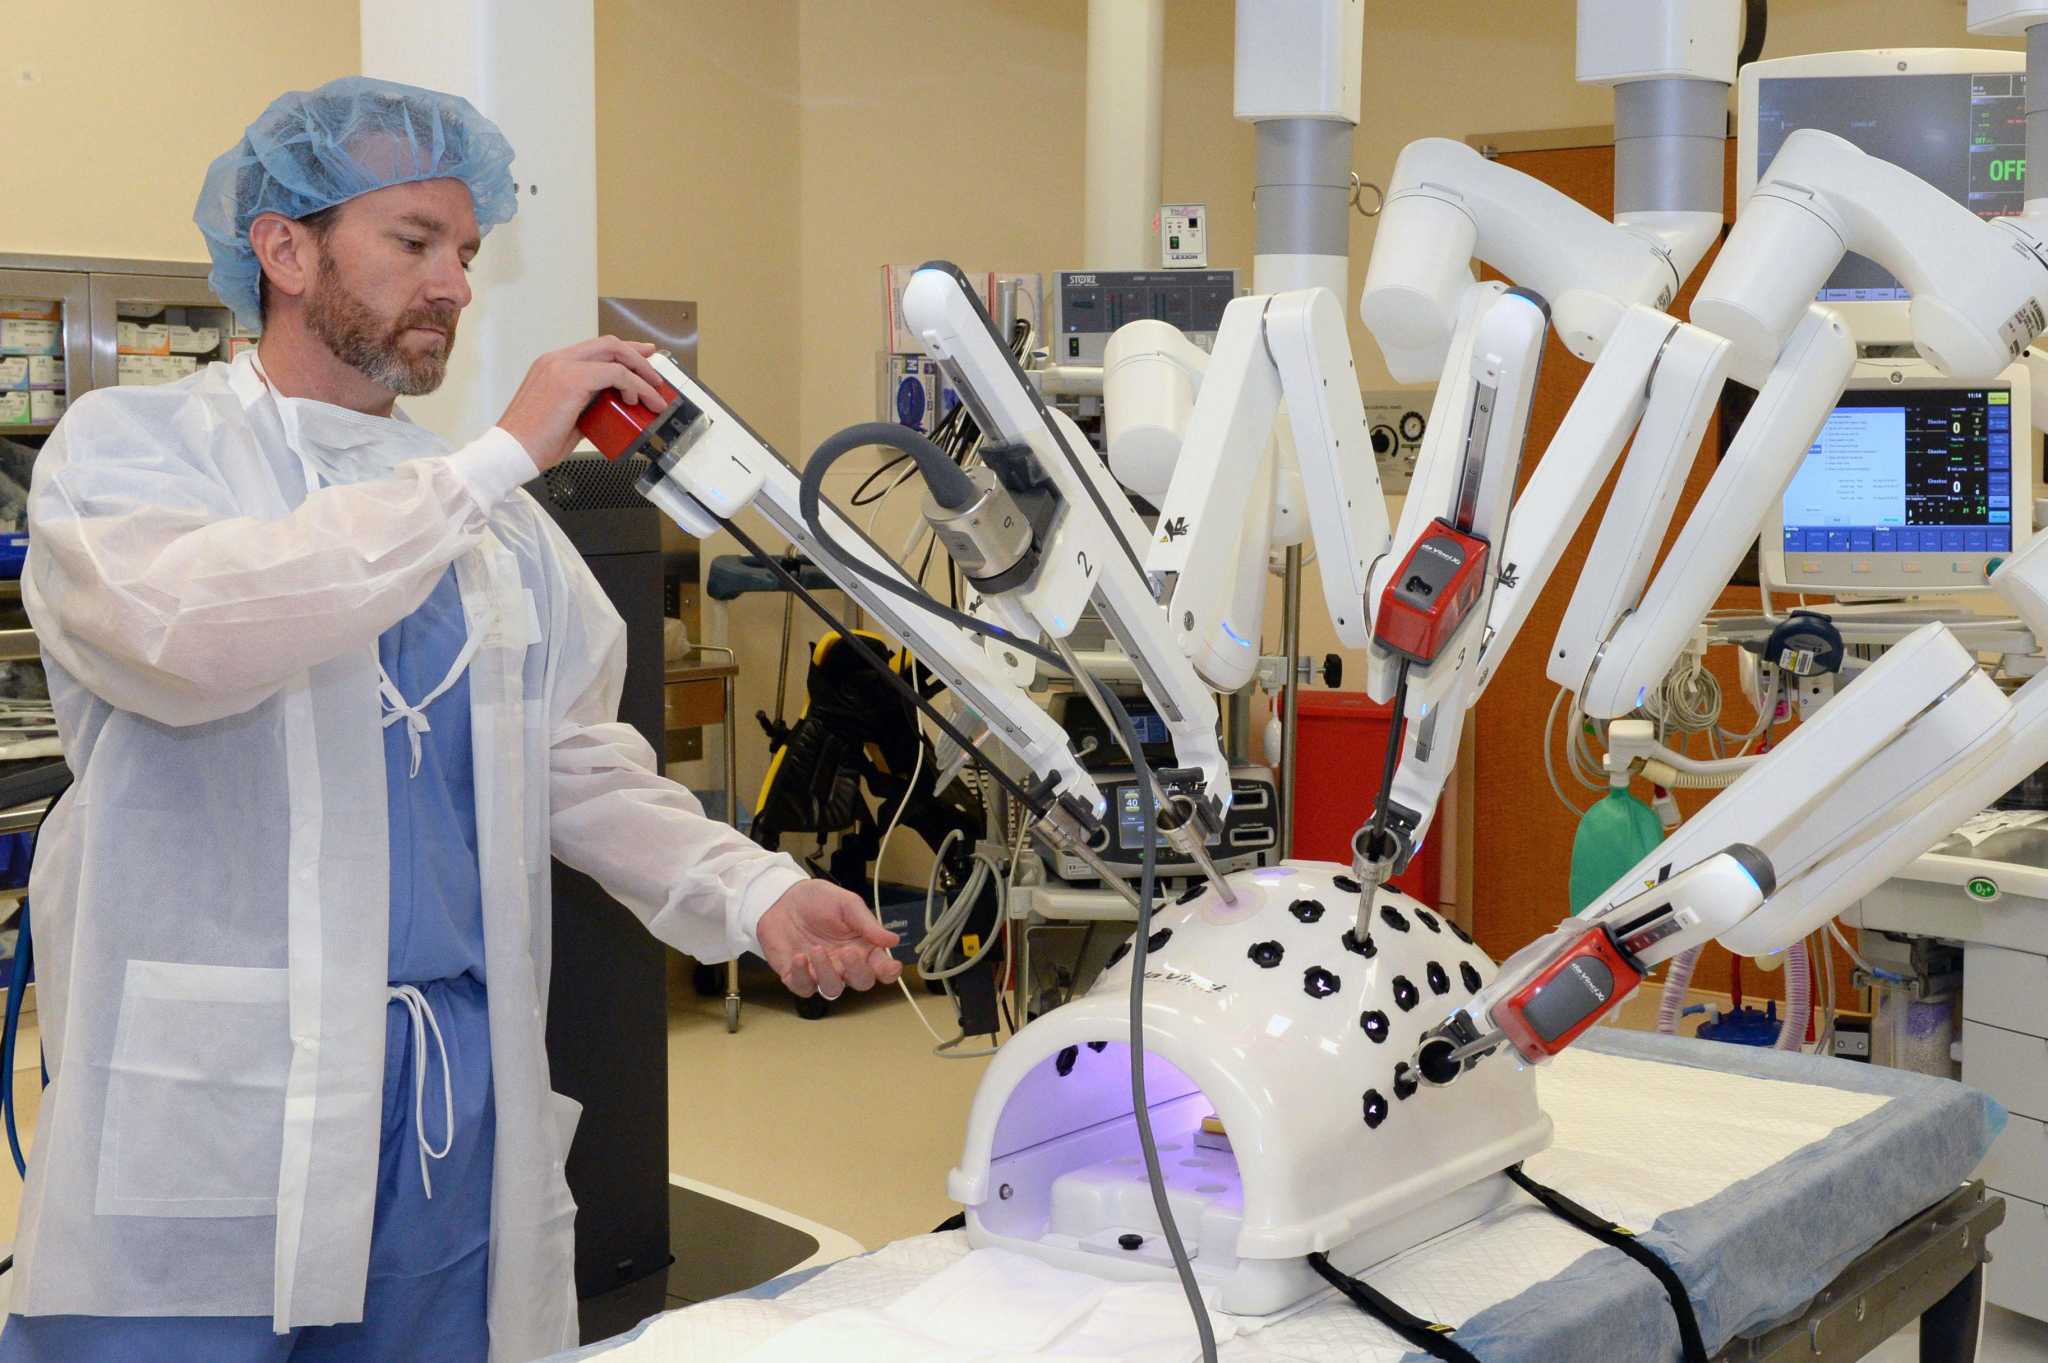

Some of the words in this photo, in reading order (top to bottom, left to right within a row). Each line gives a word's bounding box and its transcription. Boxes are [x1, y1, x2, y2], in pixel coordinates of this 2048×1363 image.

[1989, 159, 2026, 181] OFF
[1070, 274, 1097, 284] STORZ
[1952, 421, 1961, 434] 0
[731, 455, 751, 474] 1
[1953, 480, 1961, 493] 0
[1976, 505, 1986, 515] 21
[1077, 550, 1093, 578] 2
[1126, 799, 1138, 807] 40
